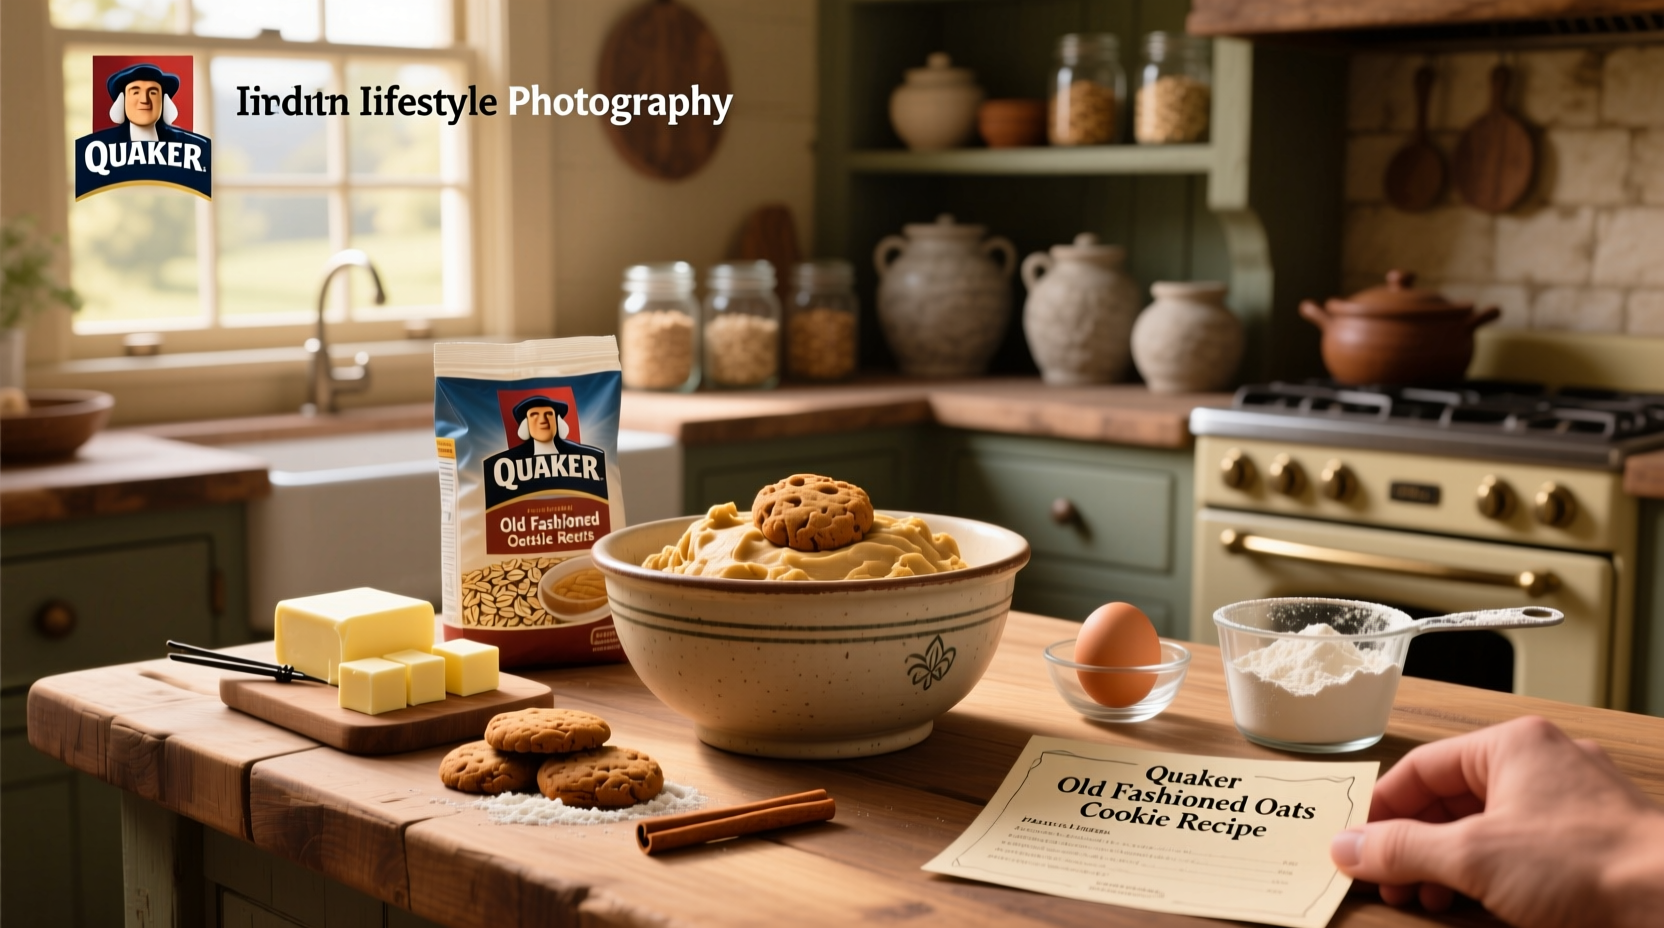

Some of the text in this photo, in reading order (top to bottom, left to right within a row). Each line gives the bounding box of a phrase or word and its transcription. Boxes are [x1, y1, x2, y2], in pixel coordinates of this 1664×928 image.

[493, 454, 601, 491] QUAKER
[500, 510, 600, 533] Old Fashioned
[1145, 765, 1242, 790] Quaker
[1056, 775, 1317, 821] Old Fashioned Oats
[1079, 801, 1171, 828] Cookie
[1176, 812, 1268, 841] Recipe
